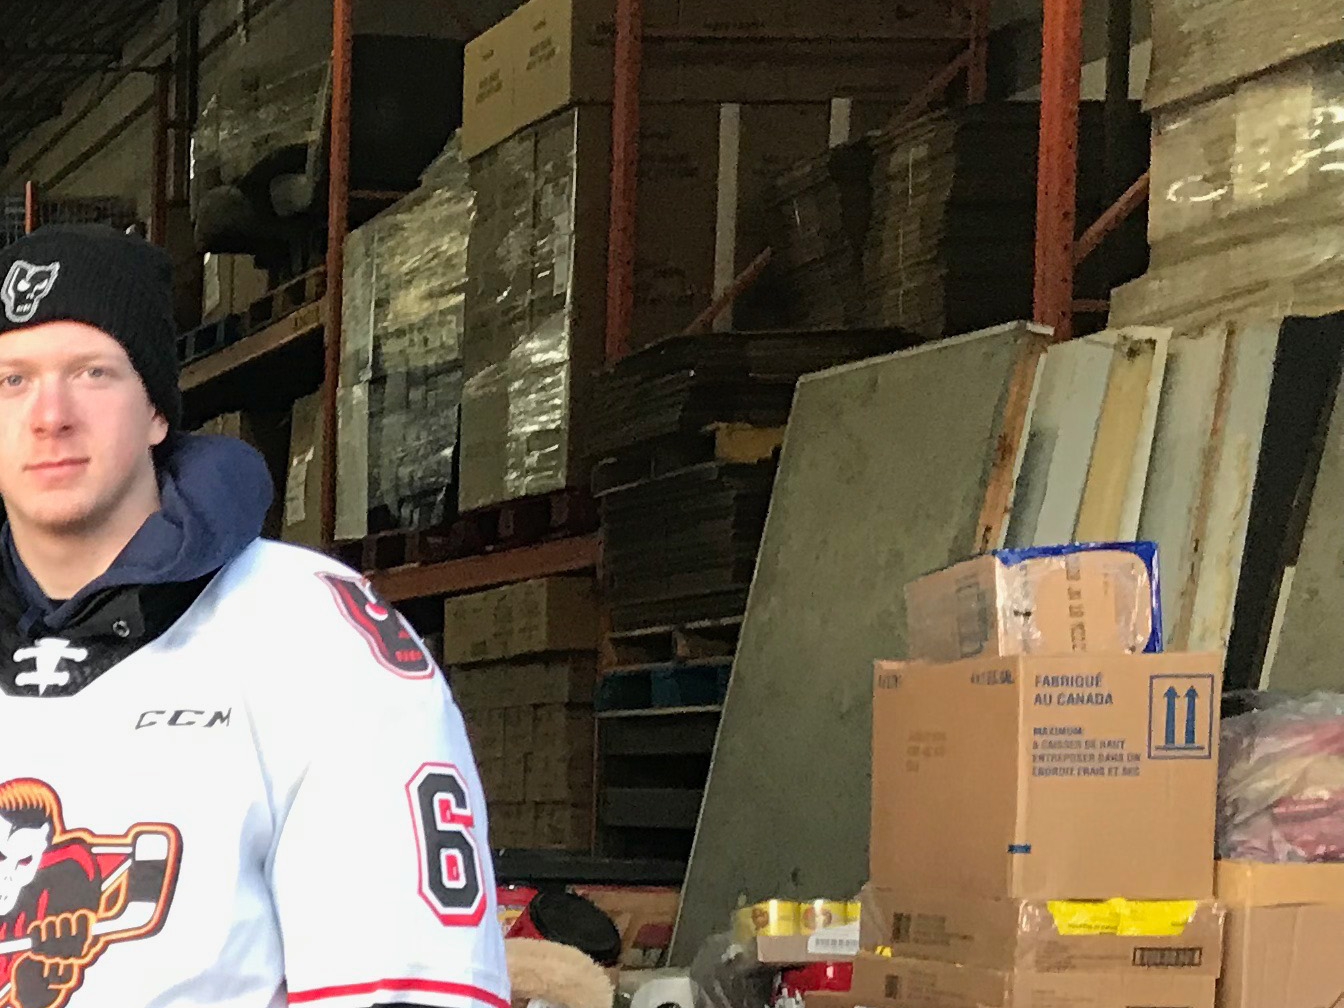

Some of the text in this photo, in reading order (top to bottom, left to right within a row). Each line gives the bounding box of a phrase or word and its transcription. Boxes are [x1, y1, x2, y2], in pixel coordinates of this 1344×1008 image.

[1033, 692, 1114, 706] AU CANADA
[135, 706, 233, 730] CCM
[410, 766, 484, 920] 6
